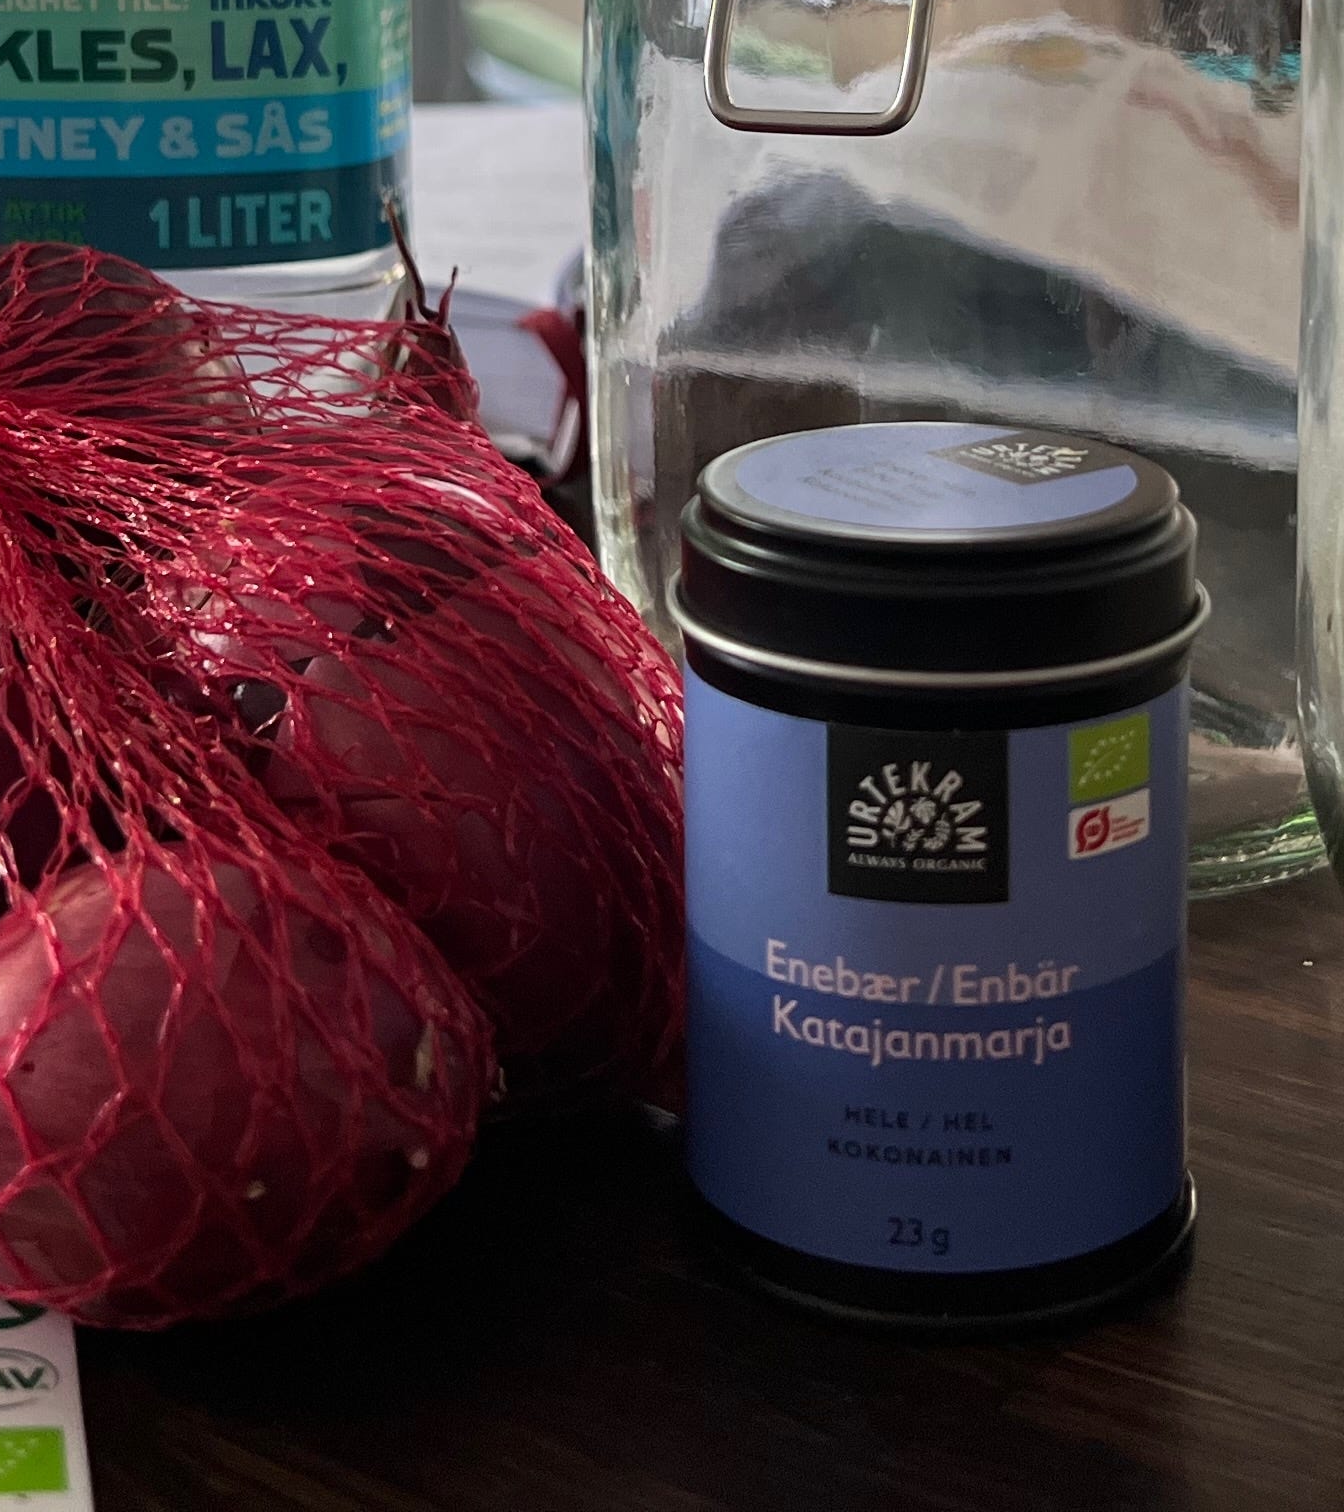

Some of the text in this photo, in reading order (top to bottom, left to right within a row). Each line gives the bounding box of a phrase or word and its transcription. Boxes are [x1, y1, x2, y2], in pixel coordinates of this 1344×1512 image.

[210, 16, 348, 85] LAX,
[159, 115, 199, 160] &
[215, 102, 334, 156] SÅS
[148, 199, 172, 249] 1
[187, 188, 333, 248] LITER
[847, 759, 989, 853] URTEKRAM
[847, 852, 988, 872] ALWAYS ORGANIC
[771, 993, 1072, 1066] Katajanmarja
[844, 1103, 910, 1130] HELE
[943, 1110, 994, 1132] HEL
[827, 1137, 1013, 1167] KOKONAINEN
[887, 1215, 951, 1256] 23 g
